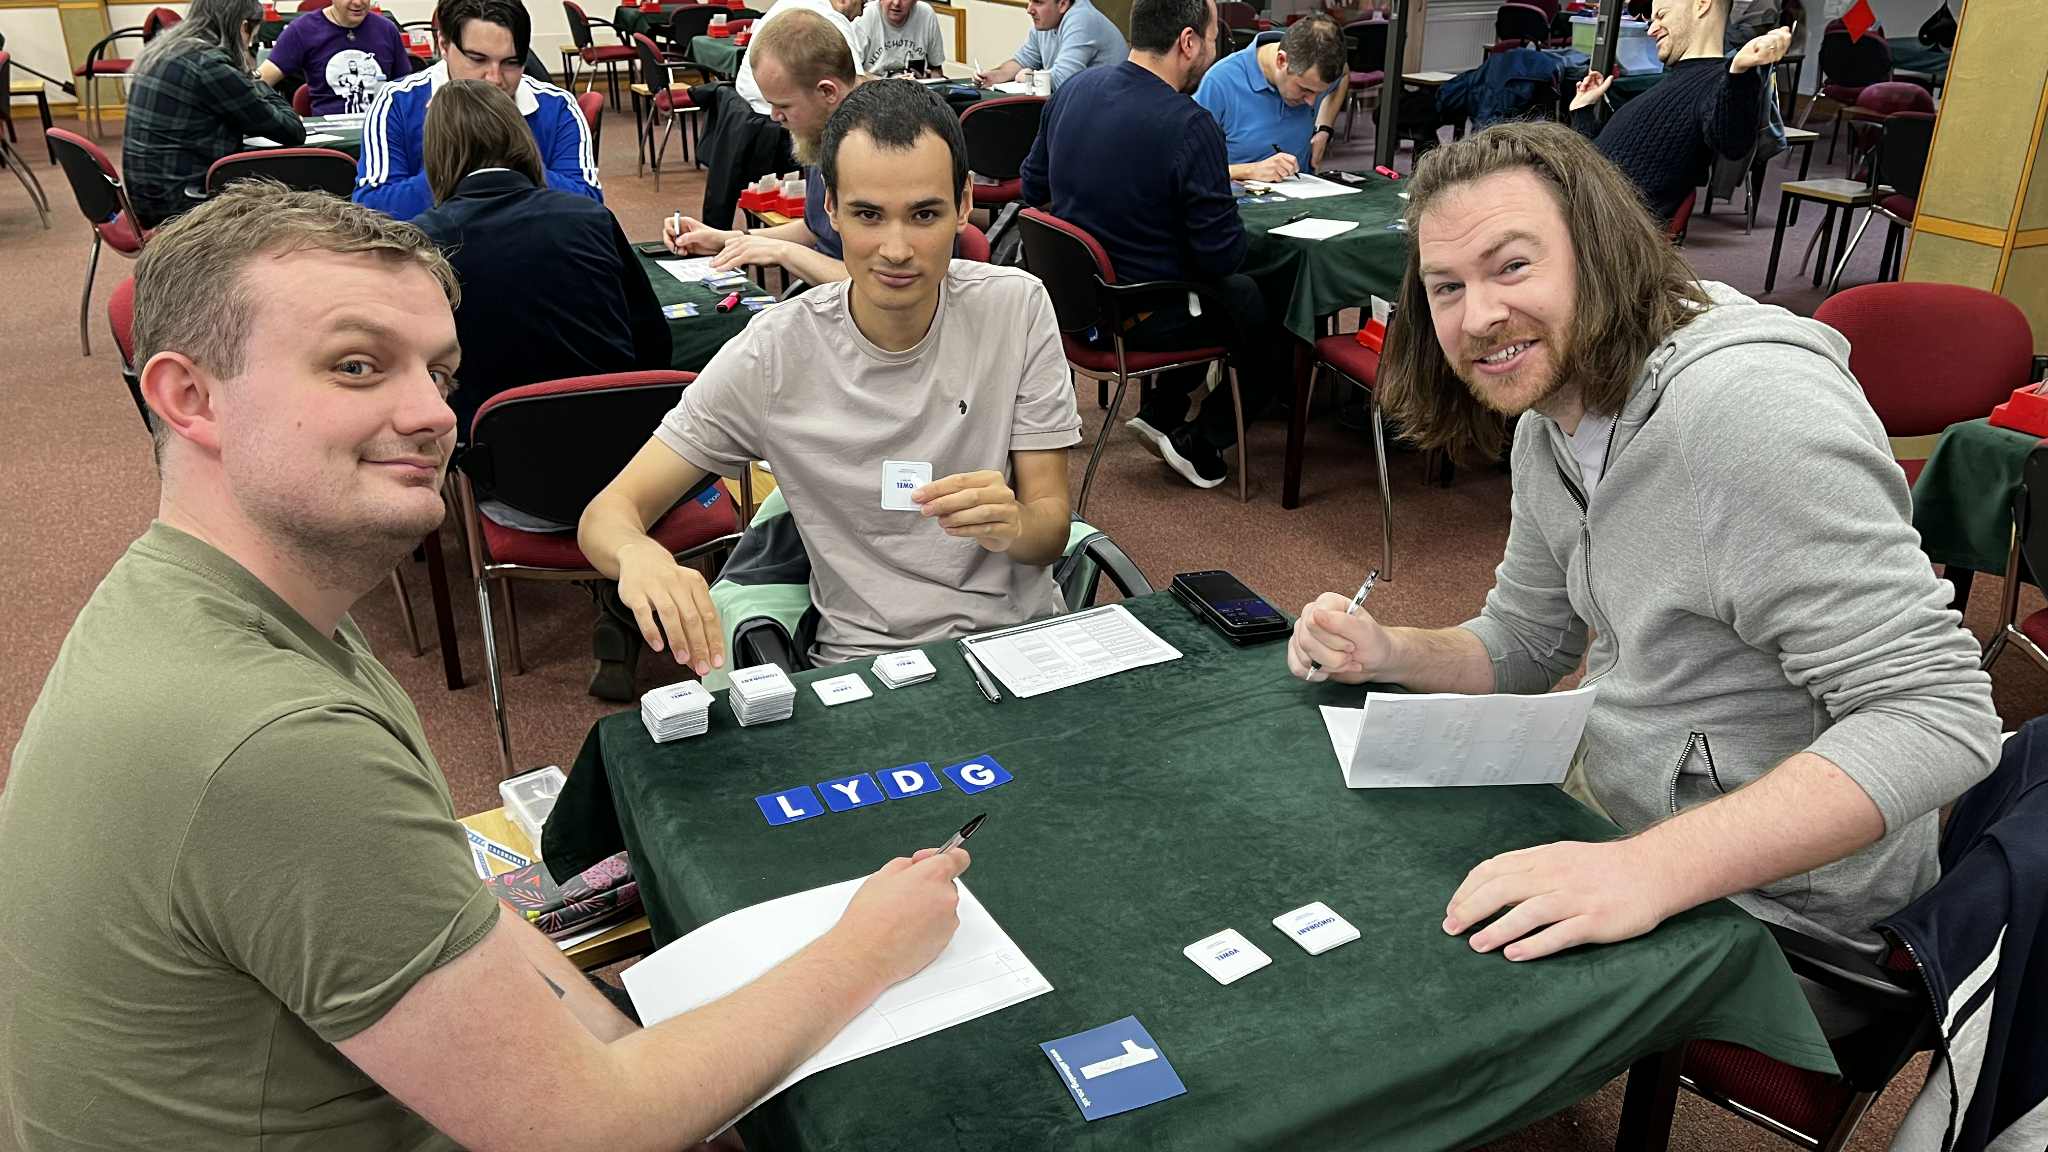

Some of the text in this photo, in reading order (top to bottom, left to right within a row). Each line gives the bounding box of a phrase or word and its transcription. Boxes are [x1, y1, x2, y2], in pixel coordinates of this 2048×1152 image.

[776, 763, 996, 818] L Y D G
[1296, 917, 1336, 935] CONSONANT
[1215, 948, 1240, 961] VOWEL
[1080, 1040, 1158, 1080] 1
